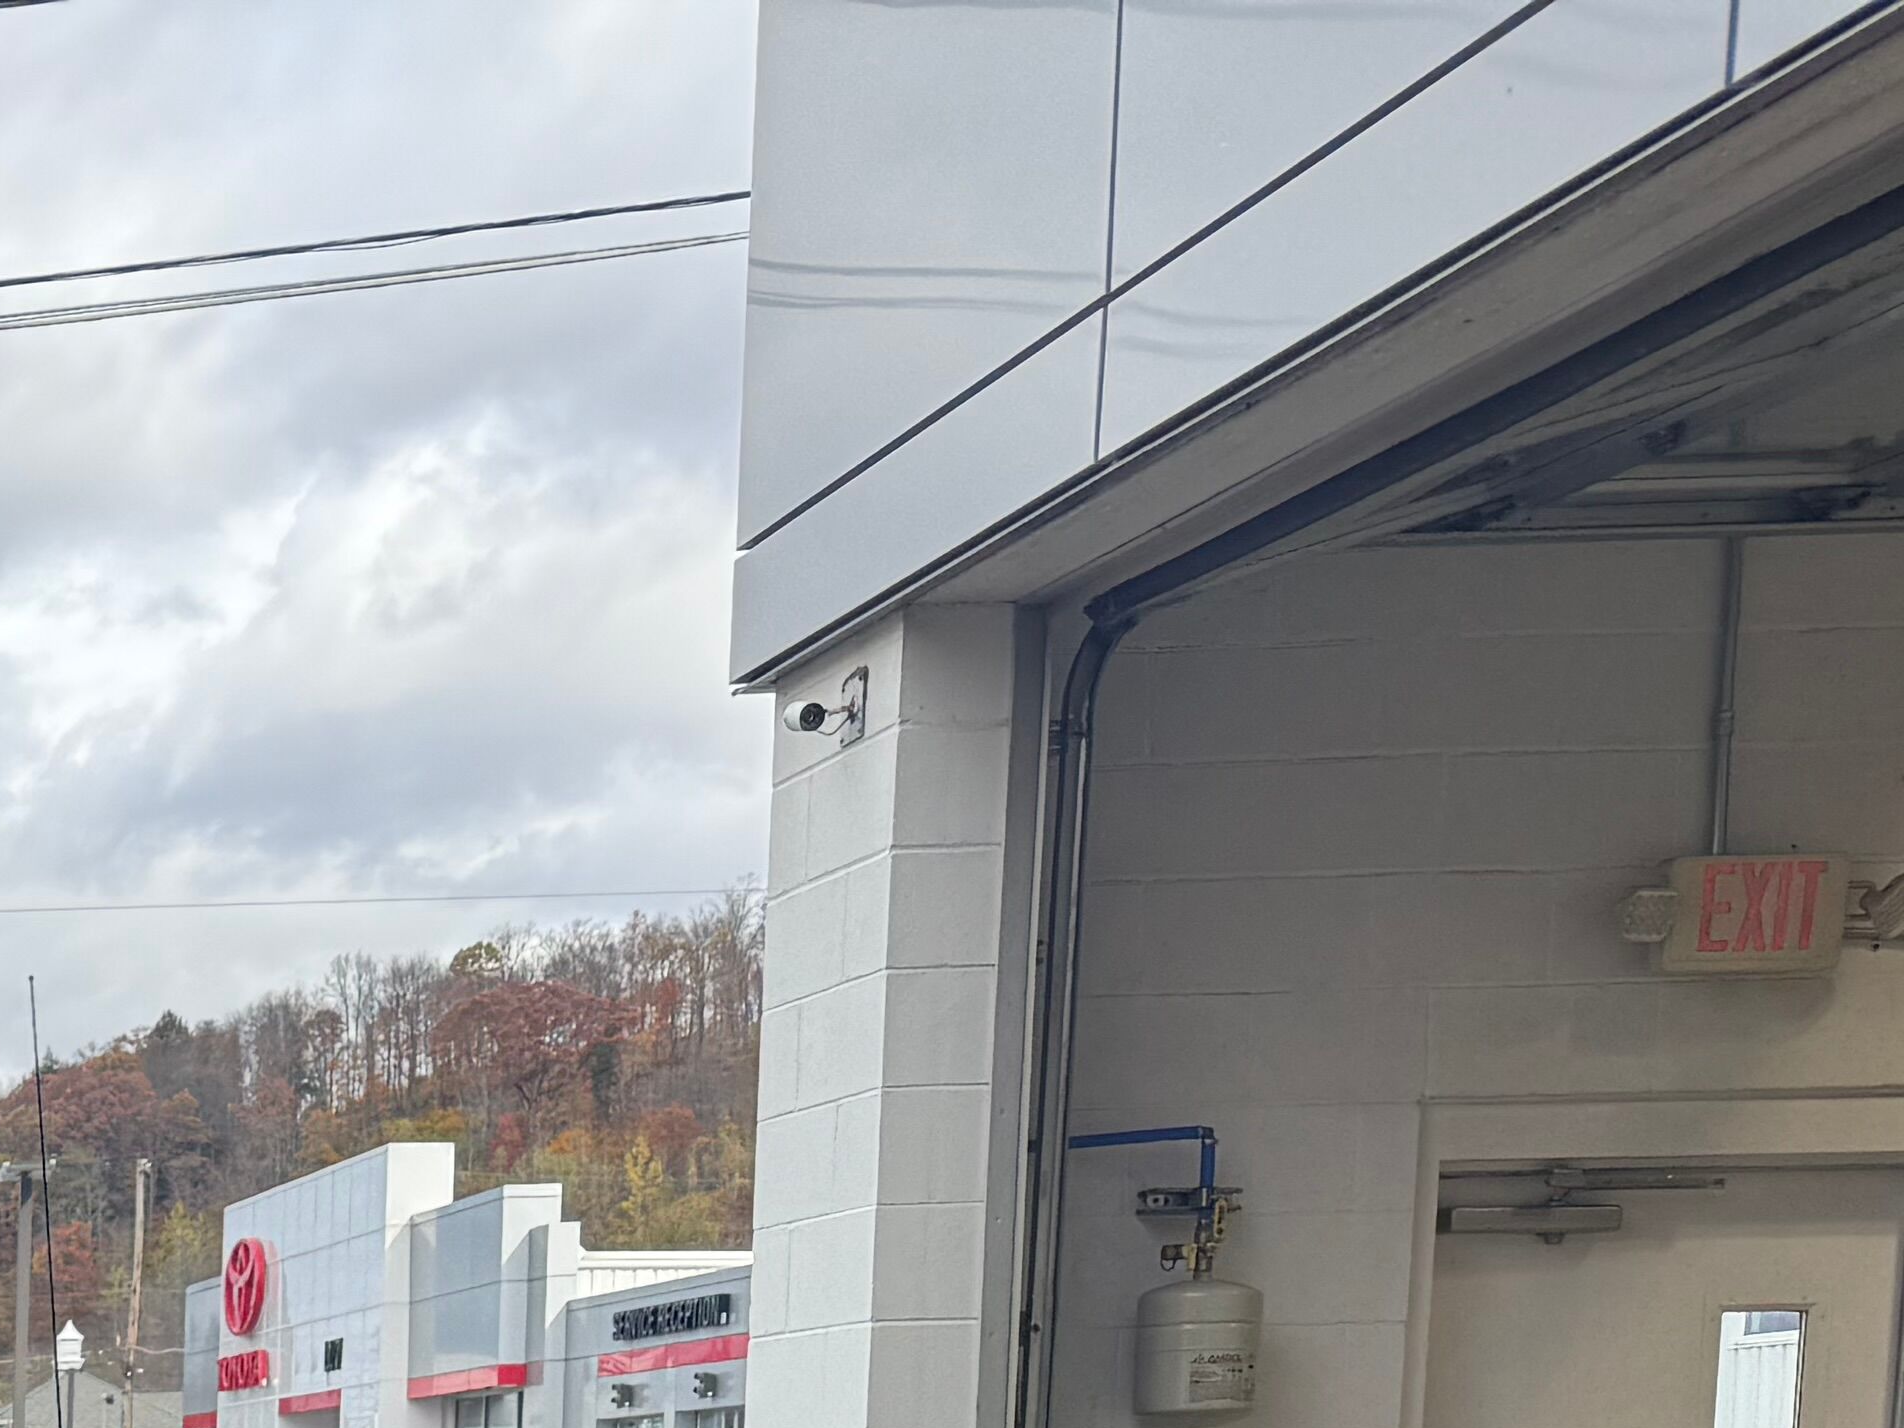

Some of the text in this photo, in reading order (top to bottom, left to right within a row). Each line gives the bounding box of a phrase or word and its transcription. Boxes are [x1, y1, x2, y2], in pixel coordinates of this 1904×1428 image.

[1696, 861, 1828, 952] EXIT
[613, 1294, 729, 1341] SERVICE RECEPTION
[218, 1349, 269, 1392] TOYOTA
